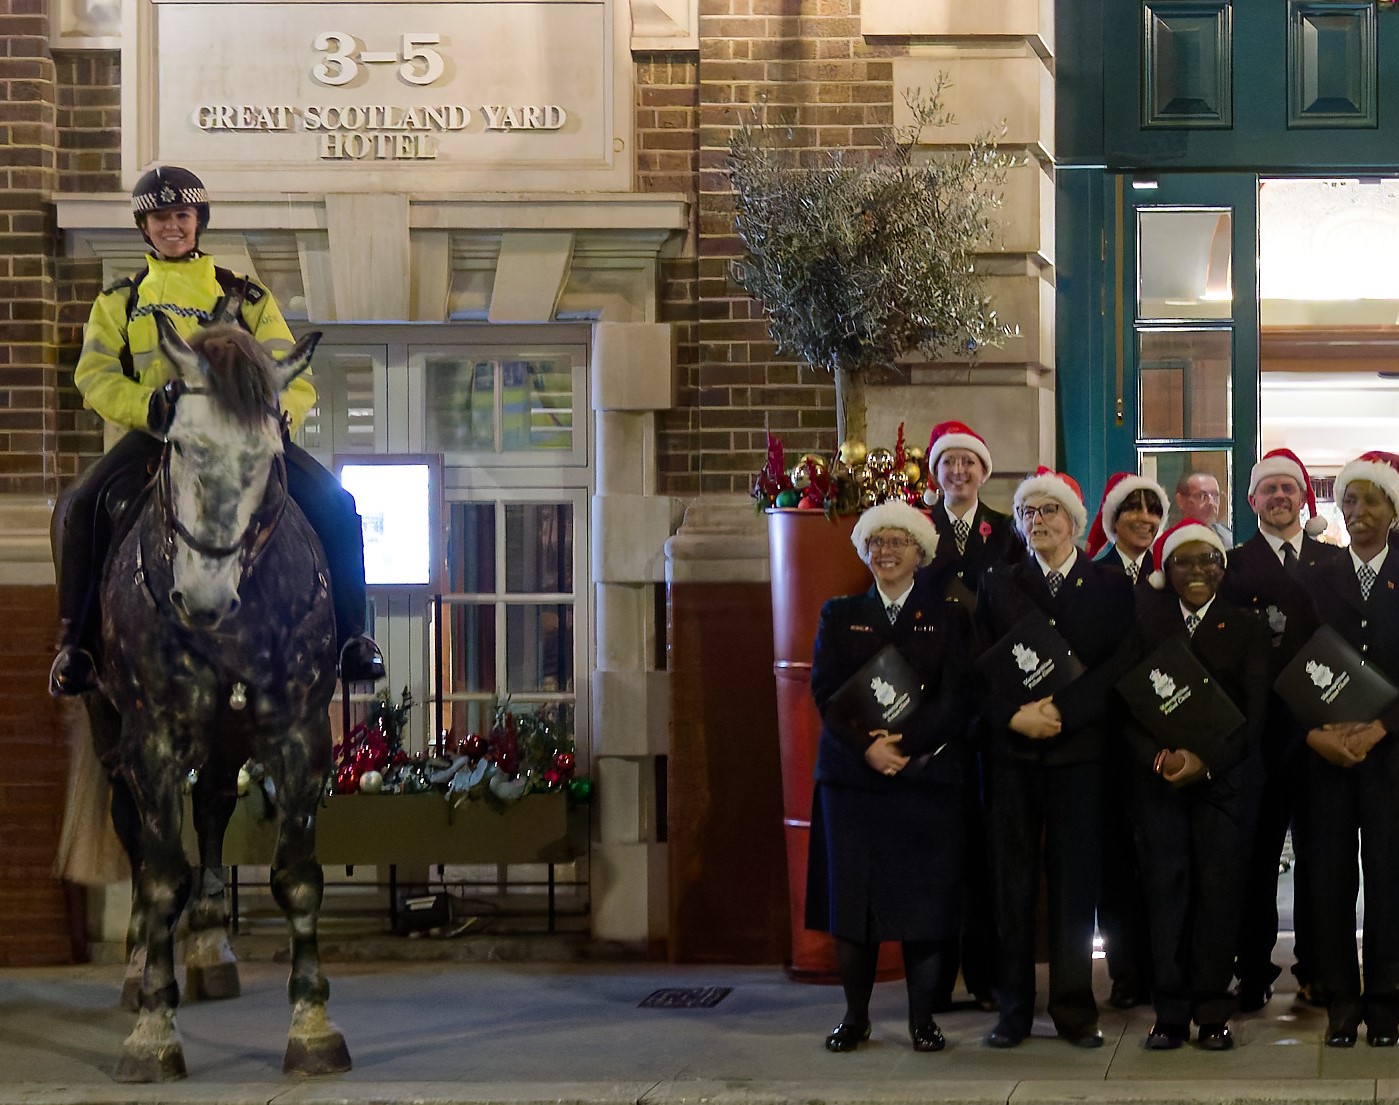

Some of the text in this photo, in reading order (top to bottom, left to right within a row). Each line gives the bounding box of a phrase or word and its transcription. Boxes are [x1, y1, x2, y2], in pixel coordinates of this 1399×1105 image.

[192, 104, 568, 131] GREAT SCOTLAND YARD
[319, 132, 438, 160] HOTEL
